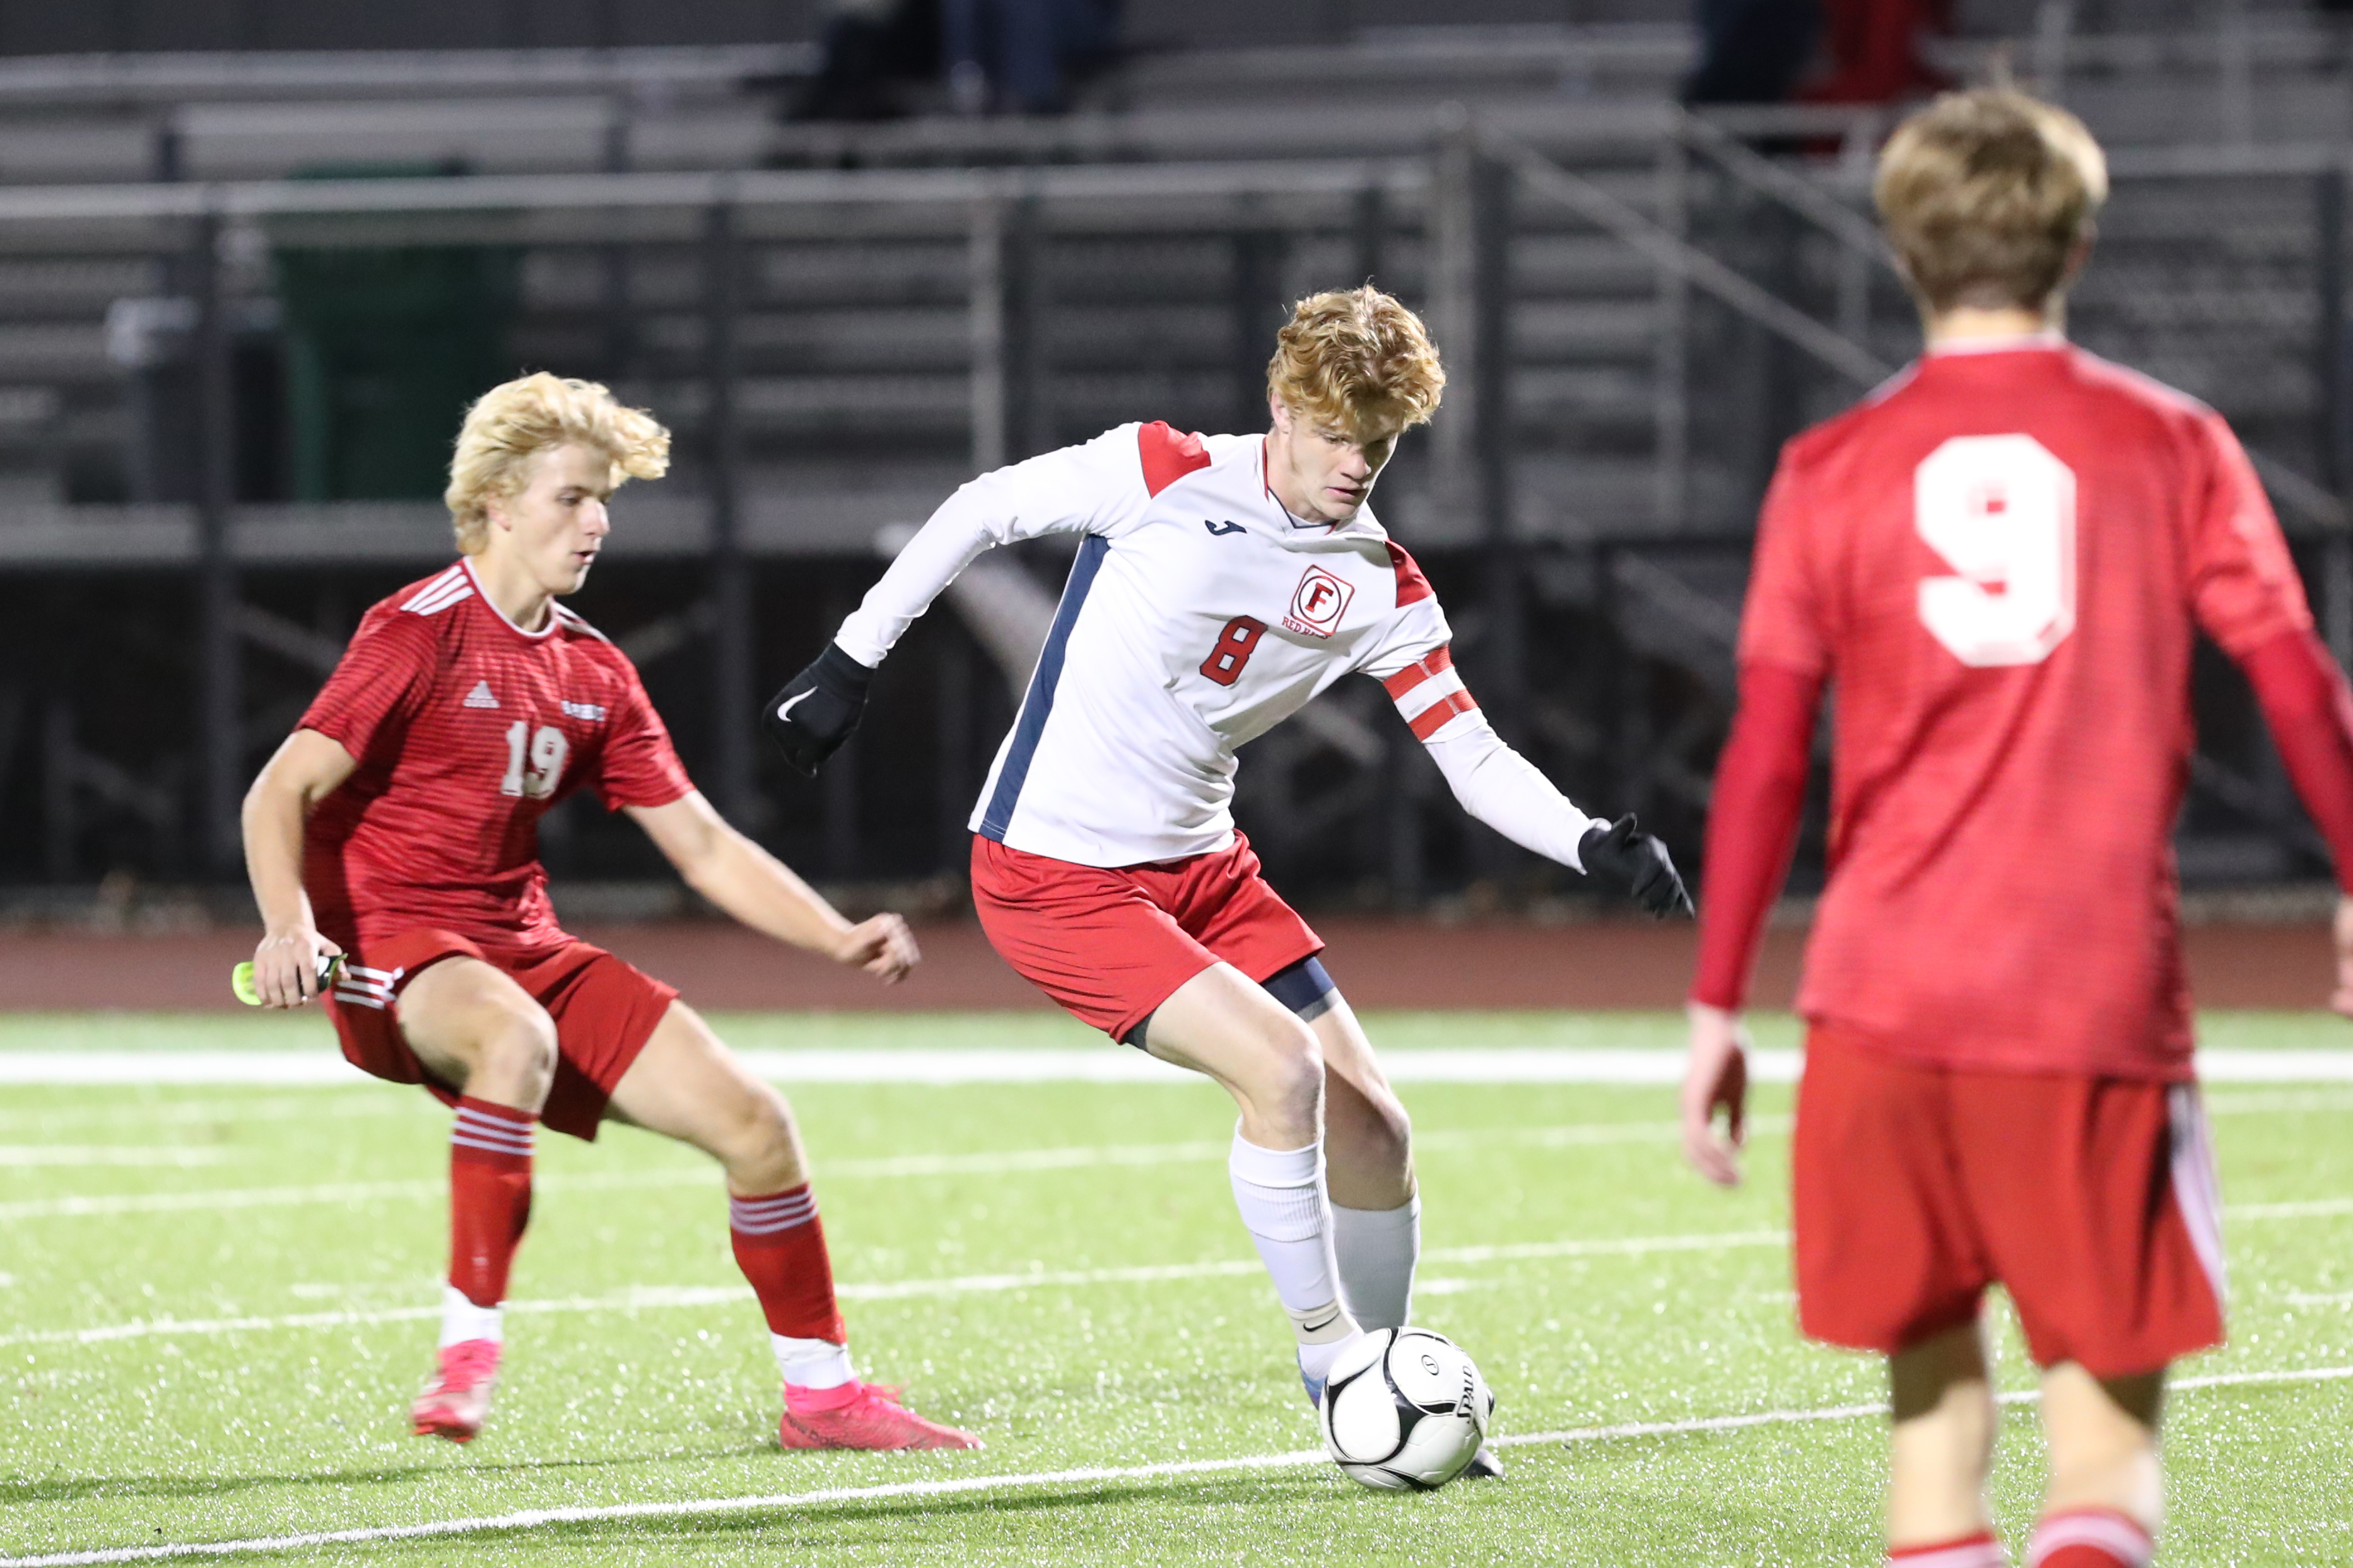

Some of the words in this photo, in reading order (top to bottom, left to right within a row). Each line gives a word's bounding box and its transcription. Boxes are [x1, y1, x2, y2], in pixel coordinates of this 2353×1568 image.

[1913, 433, 2077, 667] 9
[1282, 616, 1301, 633] RED
[1305, 582, 1333, 613] F
[1200, 615, 1269, 686] 8
[502, 720, 570, 799] 19
[1457, 1364, 1474, 1424] SPALD
